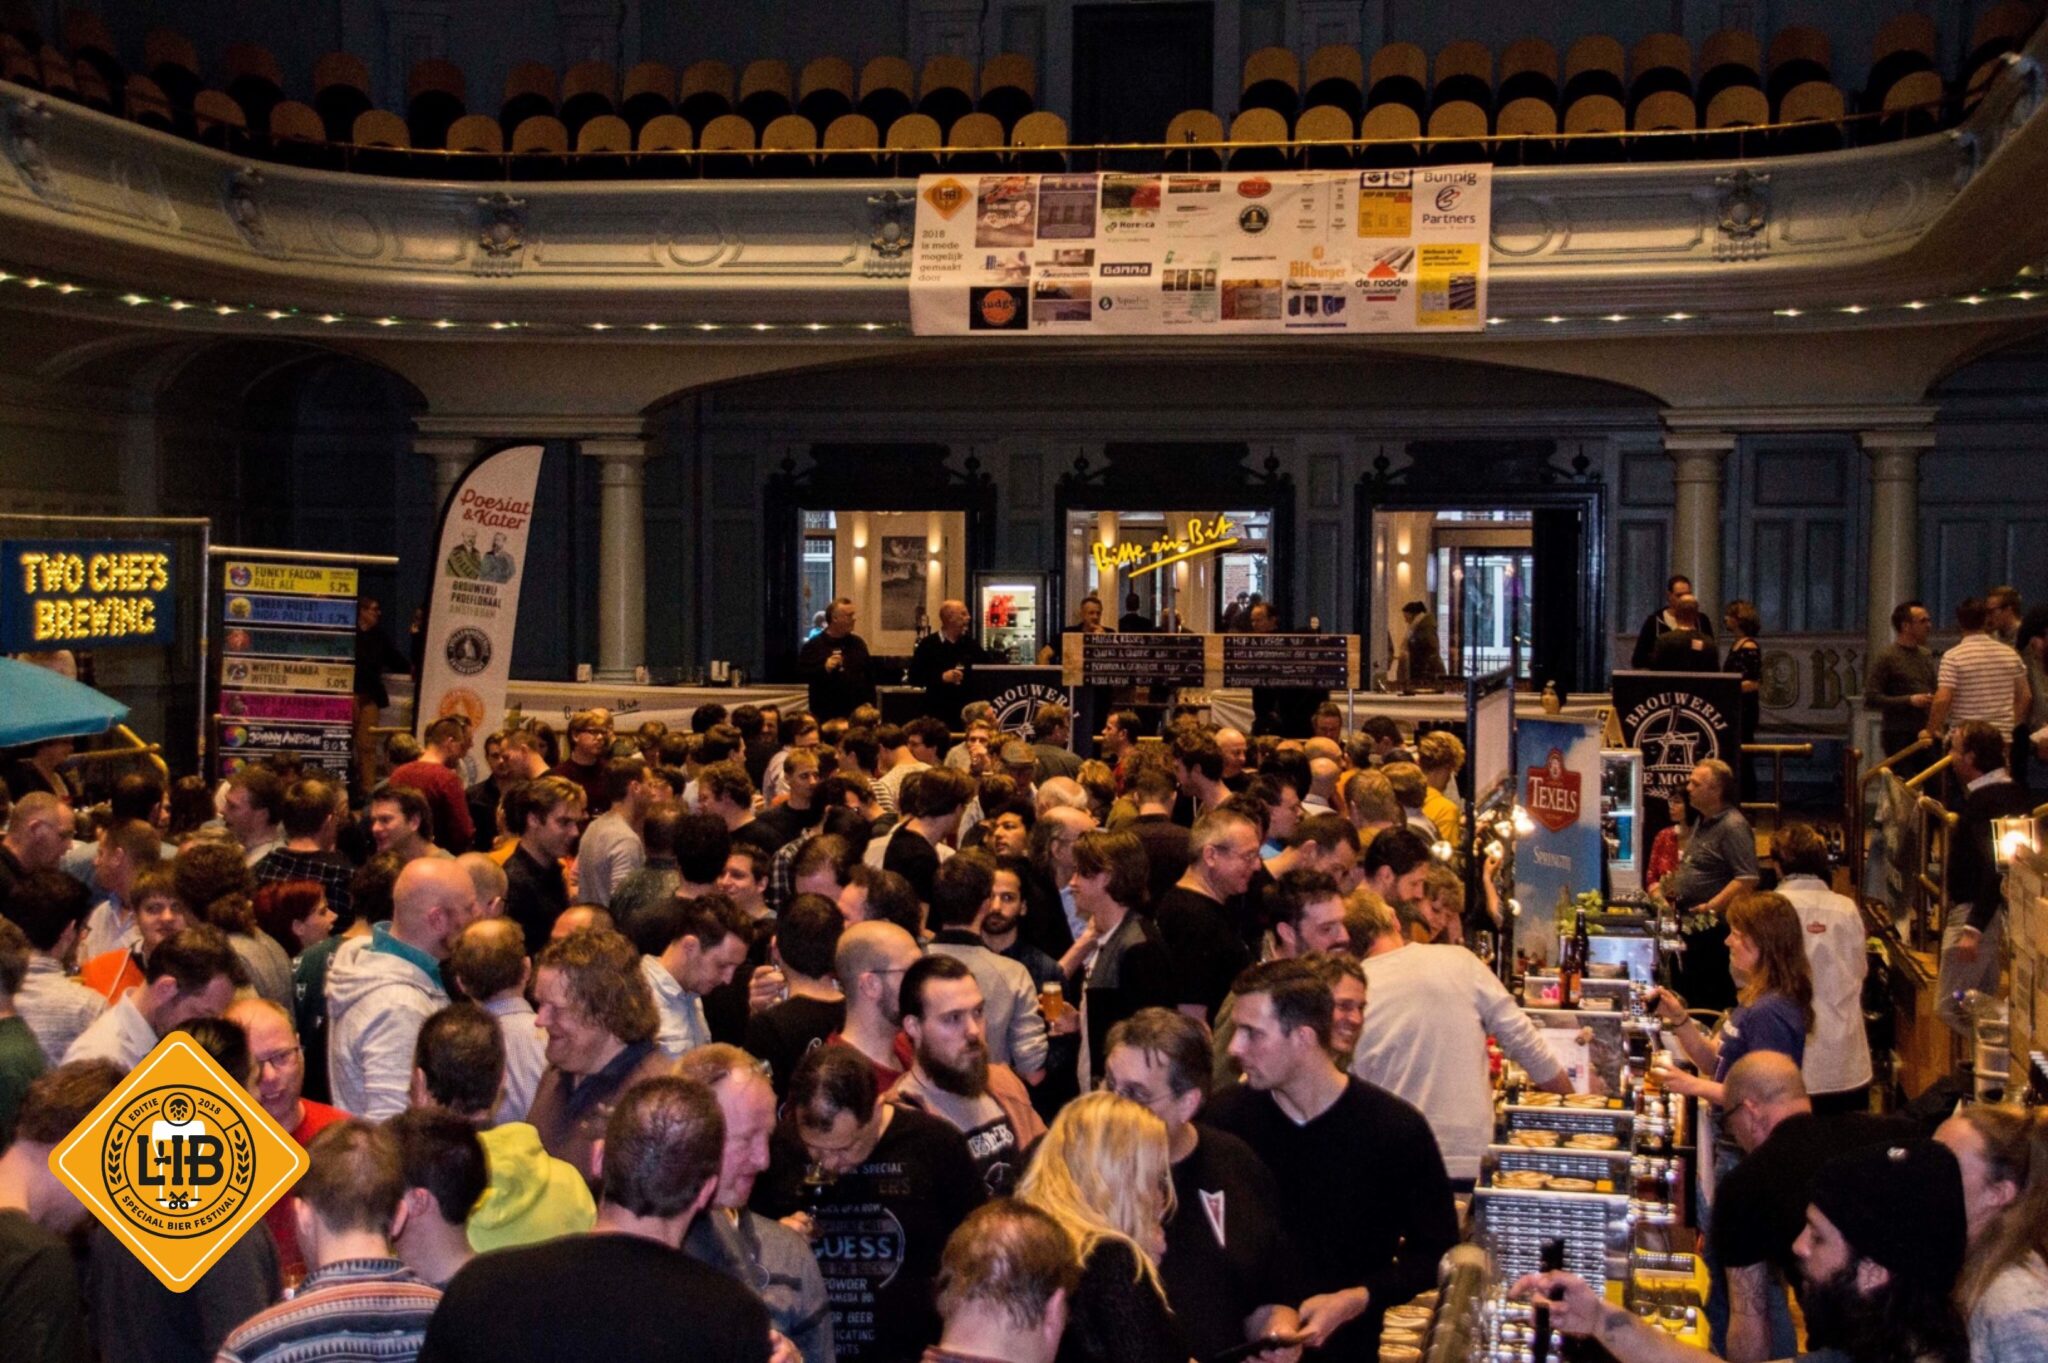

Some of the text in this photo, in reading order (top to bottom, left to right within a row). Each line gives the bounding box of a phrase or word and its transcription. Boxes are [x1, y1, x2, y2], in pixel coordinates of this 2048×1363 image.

[1422, 213, 1475, 224] Partners
[922, 230, 946, 239] 2018
[932, 241, 960, 250] mede
[921, 253, 963, 262] mogelijk
[919, 263, 961, 273] gemaakt
[1355, 277, 1409, 288] de roode
[460, 488, 531, 516] Poesiat
[1151, 533, 1187, 556] ein
[1188, 514, 1235, 546] Bit
[20, 552, 170, 594] TWO CHEFS
[255, 566, 286, 578] FUNKY
[288, 568, 323, 580] FALCON
[278, 579, 295, 590] ALE
[33, 596, 157, 641] BREWING
[1625, 692, 1728, 731] BROUWERIJ
[863, 1162, 903, 1174] SPECIAL
[816, 1236, 892, 1258] UESS
[836, 1329, 875, 1341] ICATING
[835, 1343, 860, 1355] RITS
